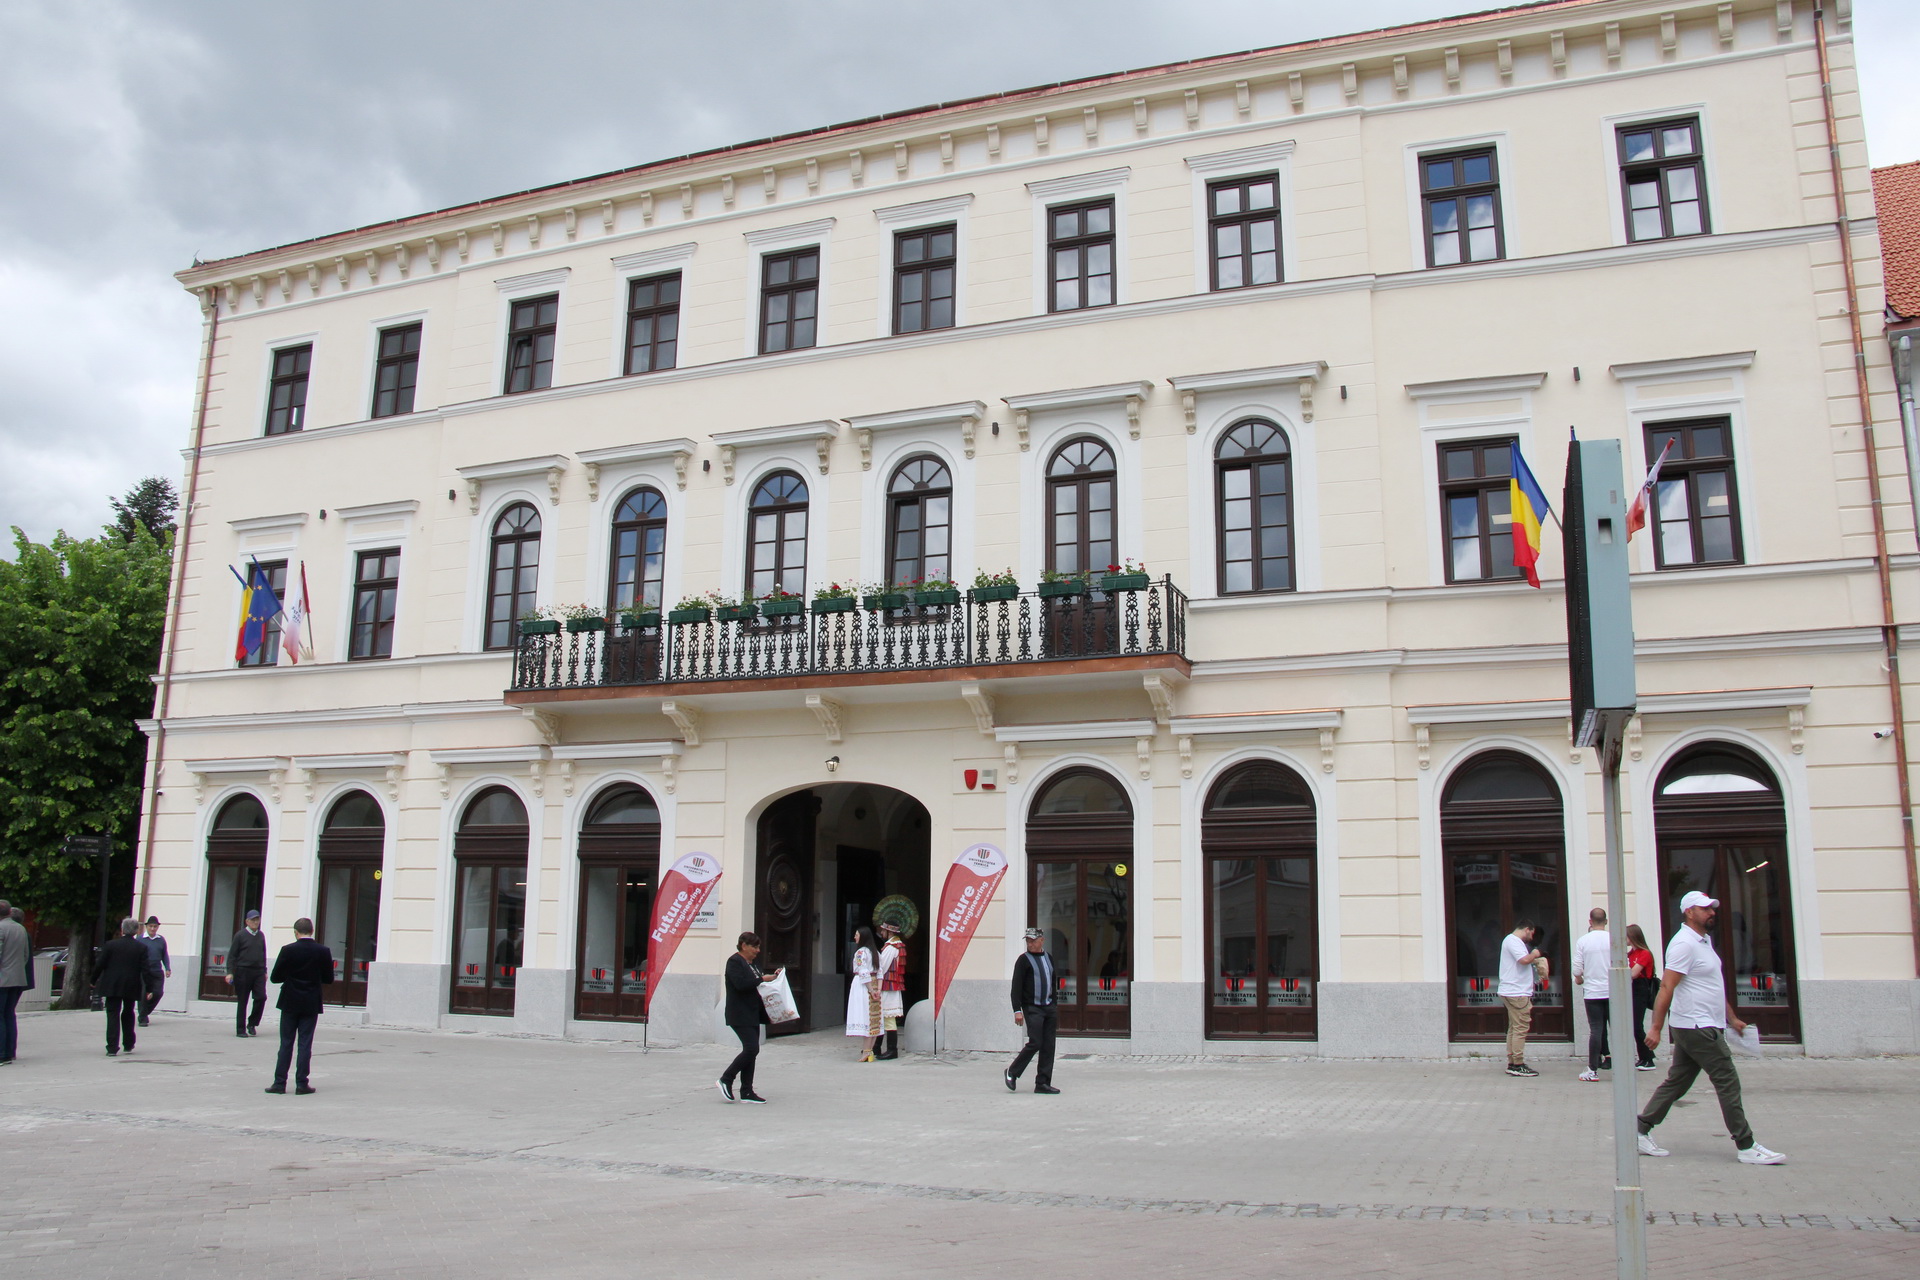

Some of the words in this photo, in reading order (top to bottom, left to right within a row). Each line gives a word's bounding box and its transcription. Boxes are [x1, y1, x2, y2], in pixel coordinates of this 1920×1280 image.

[652, 890, 688, 942] Future
[674, 888, 702, 927] engineering
[939, 885, 974, 942] Future
[962, 881, 988, 926] engineering
